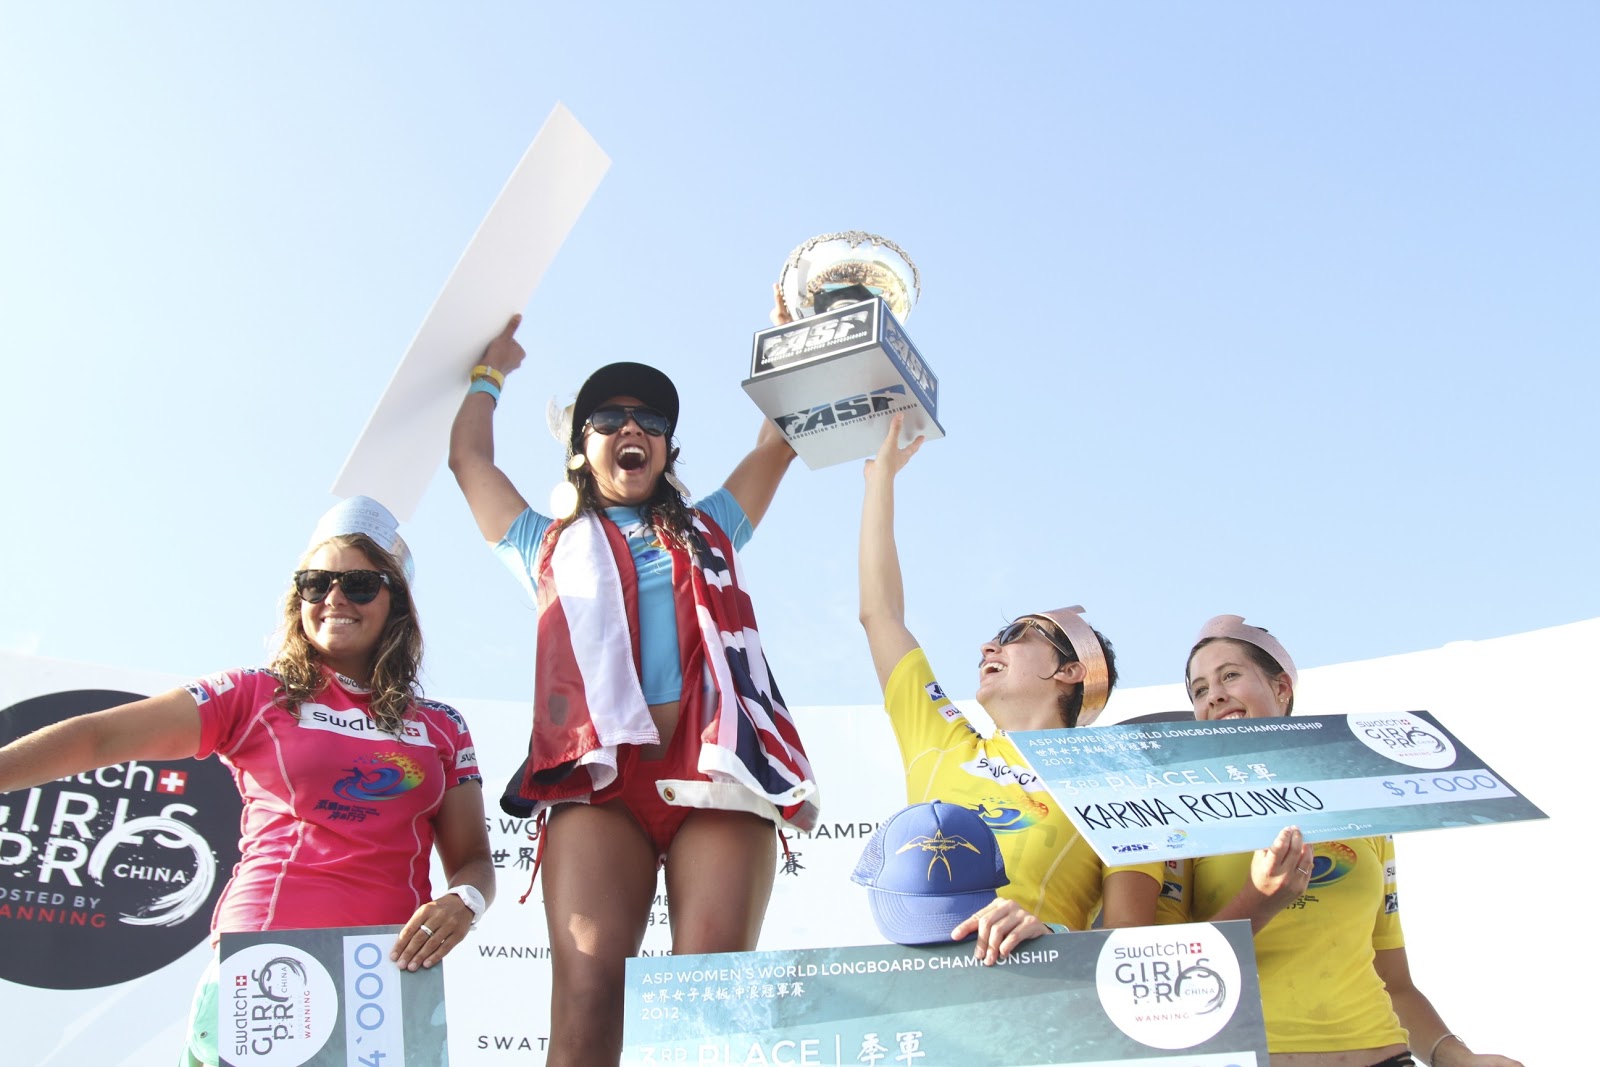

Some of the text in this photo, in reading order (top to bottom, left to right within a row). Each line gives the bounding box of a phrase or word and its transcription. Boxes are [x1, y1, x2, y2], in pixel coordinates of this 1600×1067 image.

[1029, 722, 1323, 747] ASP WOMEN'S WORLD LONGBOARD CHAMPIONSHIP
[1365, 727, 1426, 739] GIRLS
[1042, 757, 1075, 767] 2012
[1104, 769, 1206, 792] PLACE
[1074, 786, 1324, 830] KARINA ROZUNKO
[114, 863, 187, 884] CHINA
[0, 887, 101, 909] OSTED BY
[0, 903, 107, 929] ANNING
[1114, 941, 1189, 960] swatch
[281, 966, 289, 993] CHINA
[642, 972, 673, 985] ASP
[677, 967, 754, 983] WOMEN'S
[758, 963, 818, 979] WORLD
[821, 958, 926, 976] LONGBOARD
[1115, 958, 1210, 984] GIRLS
[1184, 987, 1216, 996] CHINA
[233, 987, 248, 1056] swatch
[251, 968, 273, 1056] GIRLS
[641, 1007, 680, 1021] 2012
[1135, 1013, 1190, 1022] WANNING
[698, 1038, 821, 1067] PLACE
